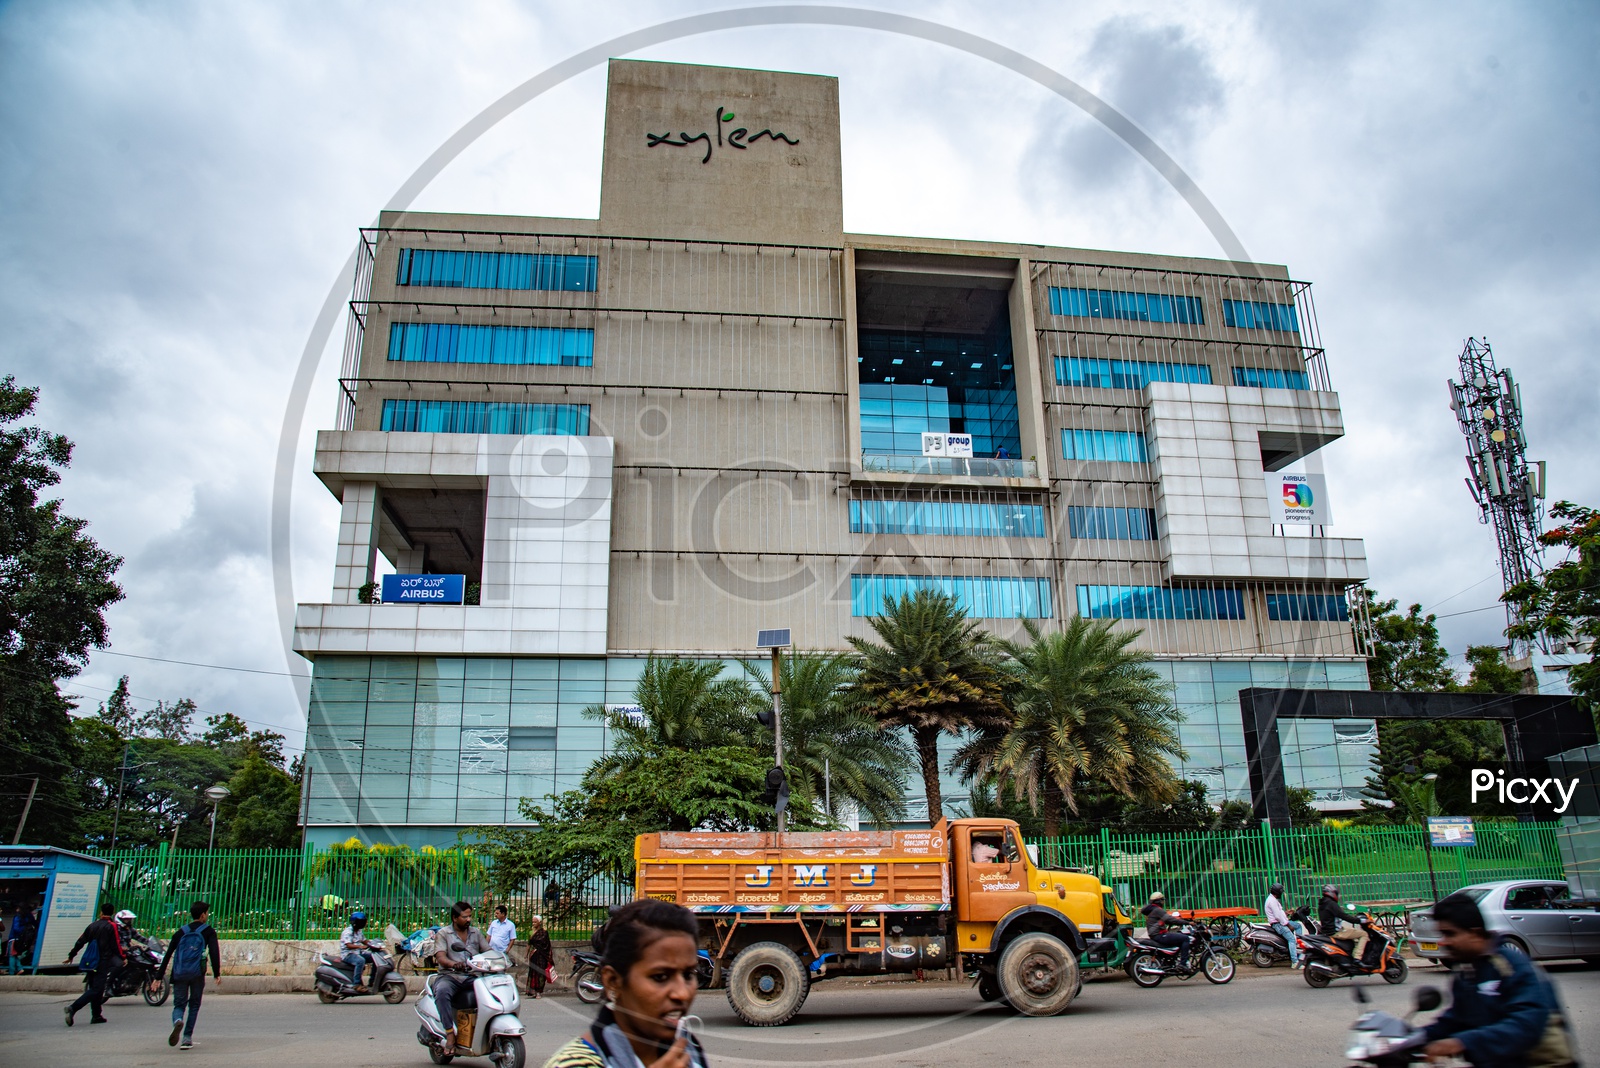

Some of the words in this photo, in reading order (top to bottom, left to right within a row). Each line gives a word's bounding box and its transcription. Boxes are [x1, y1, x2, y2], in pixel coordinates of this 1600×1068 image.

[647, 107, 799, 164] xylem
[947, 436, 970, 446] group
[1282, 484, 1314, 508] 50
[400, 589, 444, 598] AIRBUS
[745, 865, 774, 887] J
[793, 865, 829, 887] M
[850, 865, 877, 887] J
